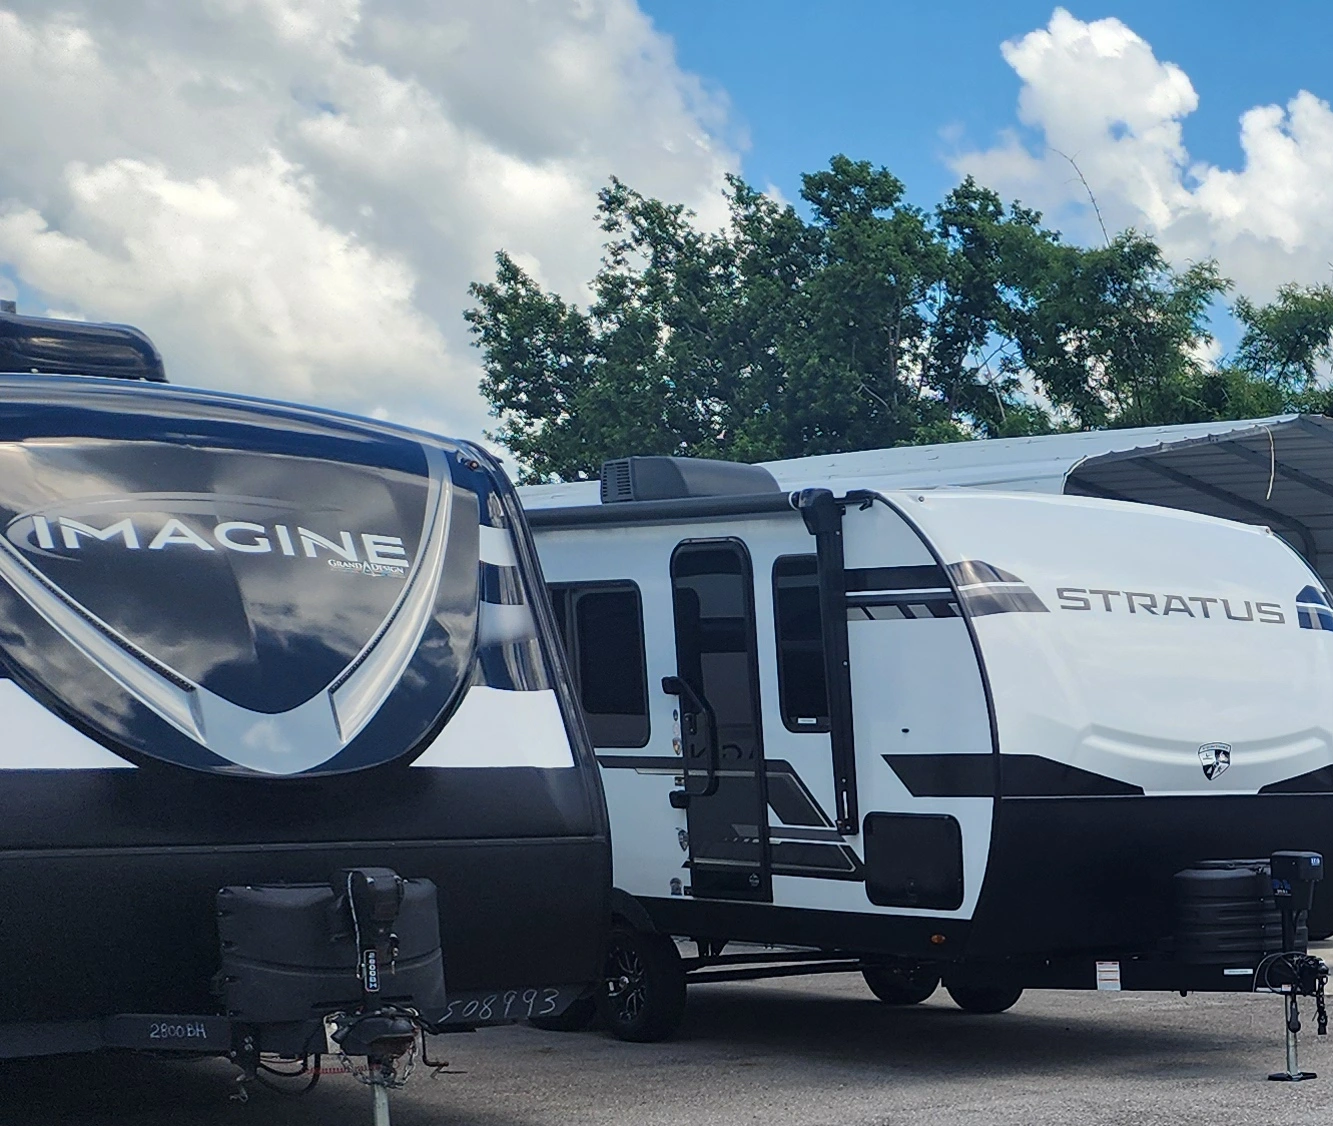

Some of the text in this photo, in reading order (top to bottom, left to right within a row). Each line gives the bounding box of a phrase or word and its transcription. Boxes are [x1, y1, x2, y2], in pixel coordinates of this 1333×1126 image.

[32, 515, 409, 568] IMAGINE
[327, 559, 405, 574] GRAND DESIGN
[1056, 587, 1286, 624] STRATUS
[438, 989, 560, 1023] 508993
[150, 1022, 207, 1039] 2800BH
